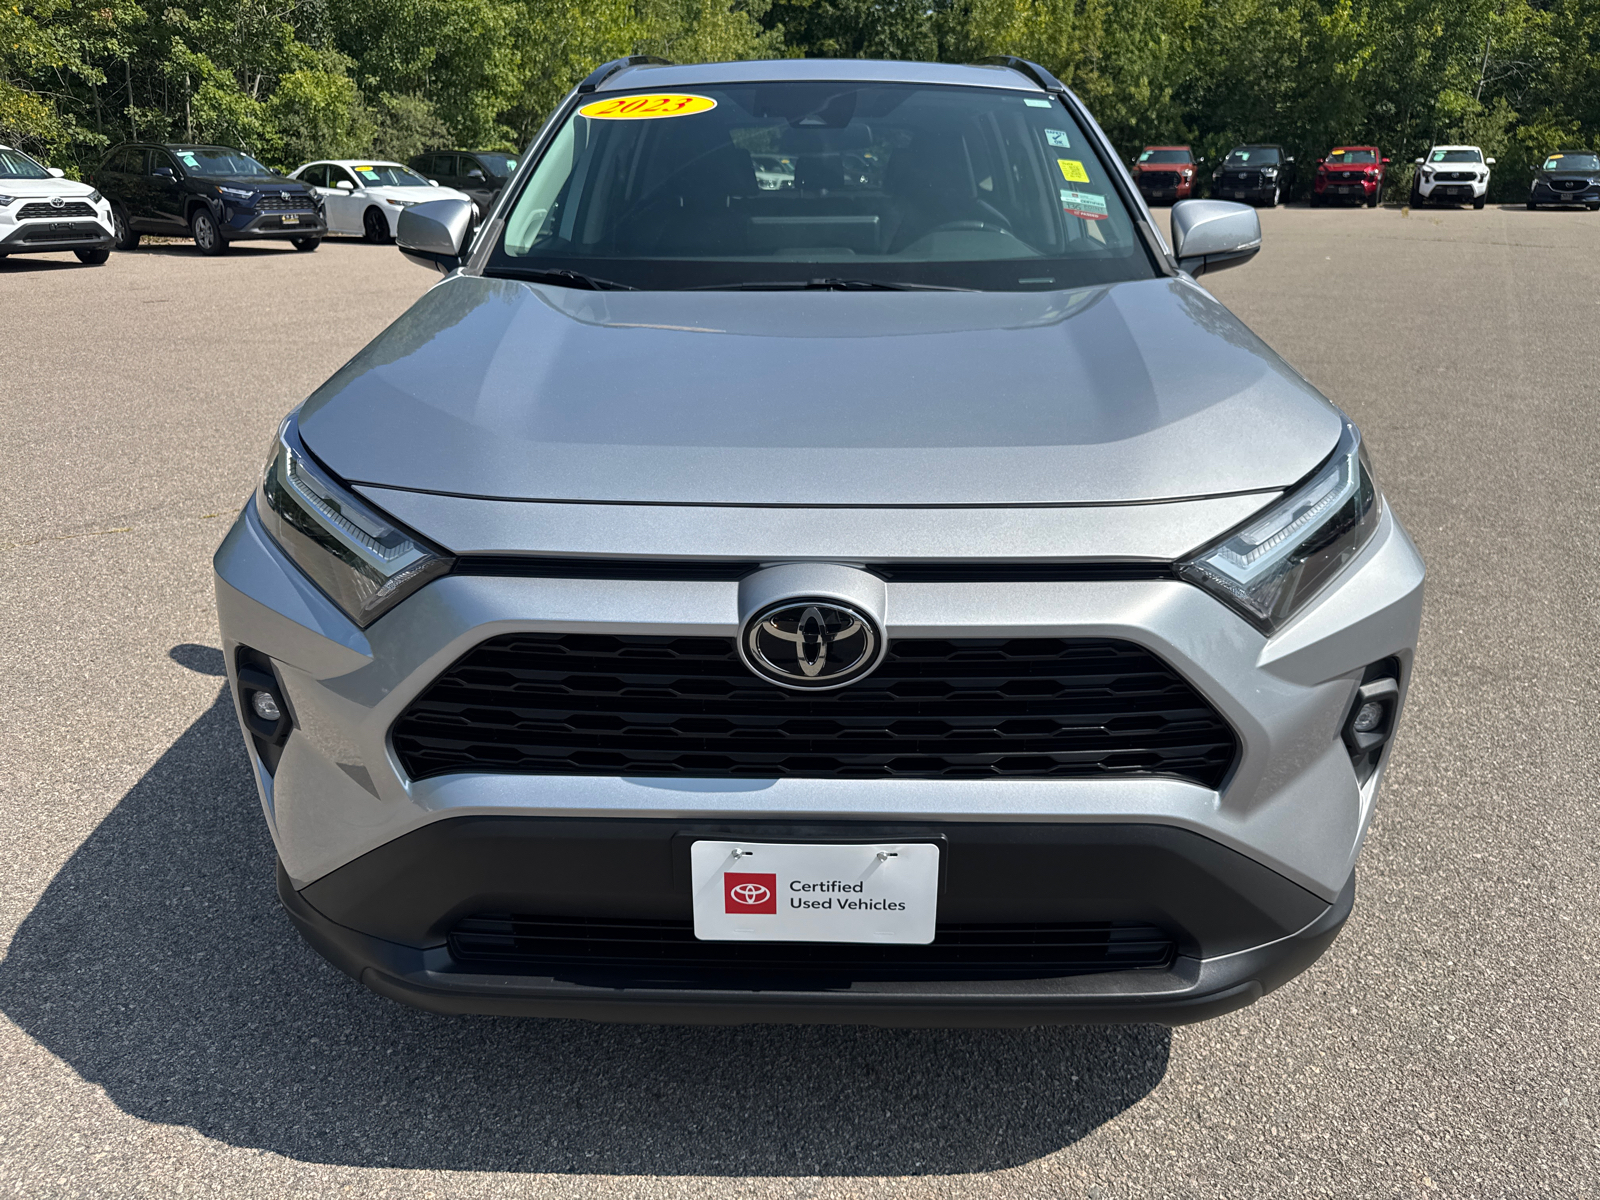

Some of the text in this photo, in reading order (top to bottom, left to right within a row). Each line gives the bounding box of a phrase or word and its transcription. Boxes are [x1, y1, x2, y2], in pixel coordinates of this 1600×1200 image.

[594, 98, 693, 115] 2023
[789, 880, 864, 893] Certified
[790, 898, 906, 911] Used Vehicles
